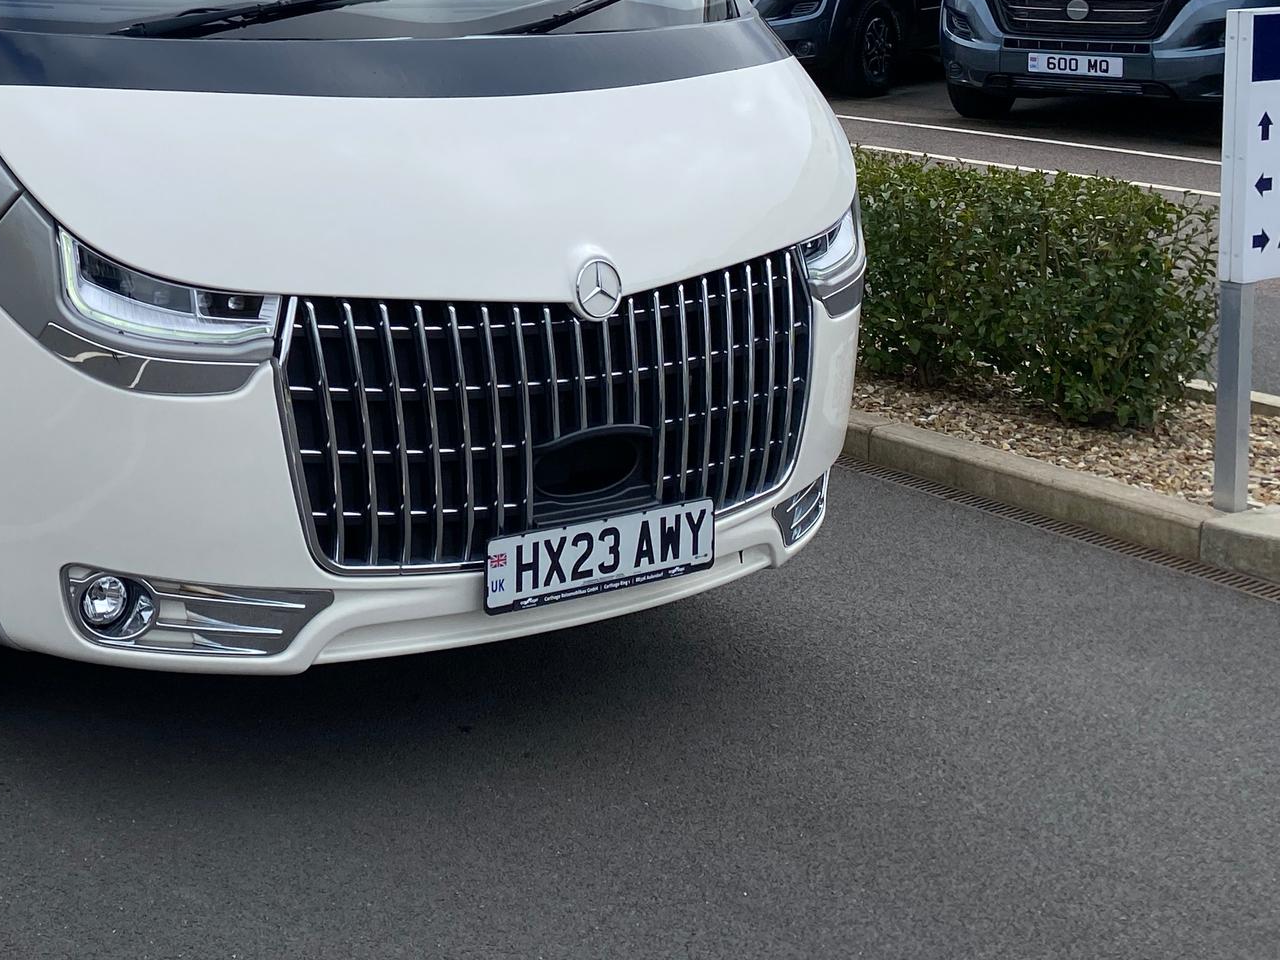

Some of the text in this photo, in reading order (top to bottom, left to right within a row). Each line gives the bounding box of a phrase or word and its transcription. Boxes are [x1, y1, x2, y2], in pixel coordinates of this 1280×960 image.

[1046, 56, 1109, 73] 600 MQ
[515, 509, 707, 593] HX23 AWY
[491, 578, 505, 593] UK
